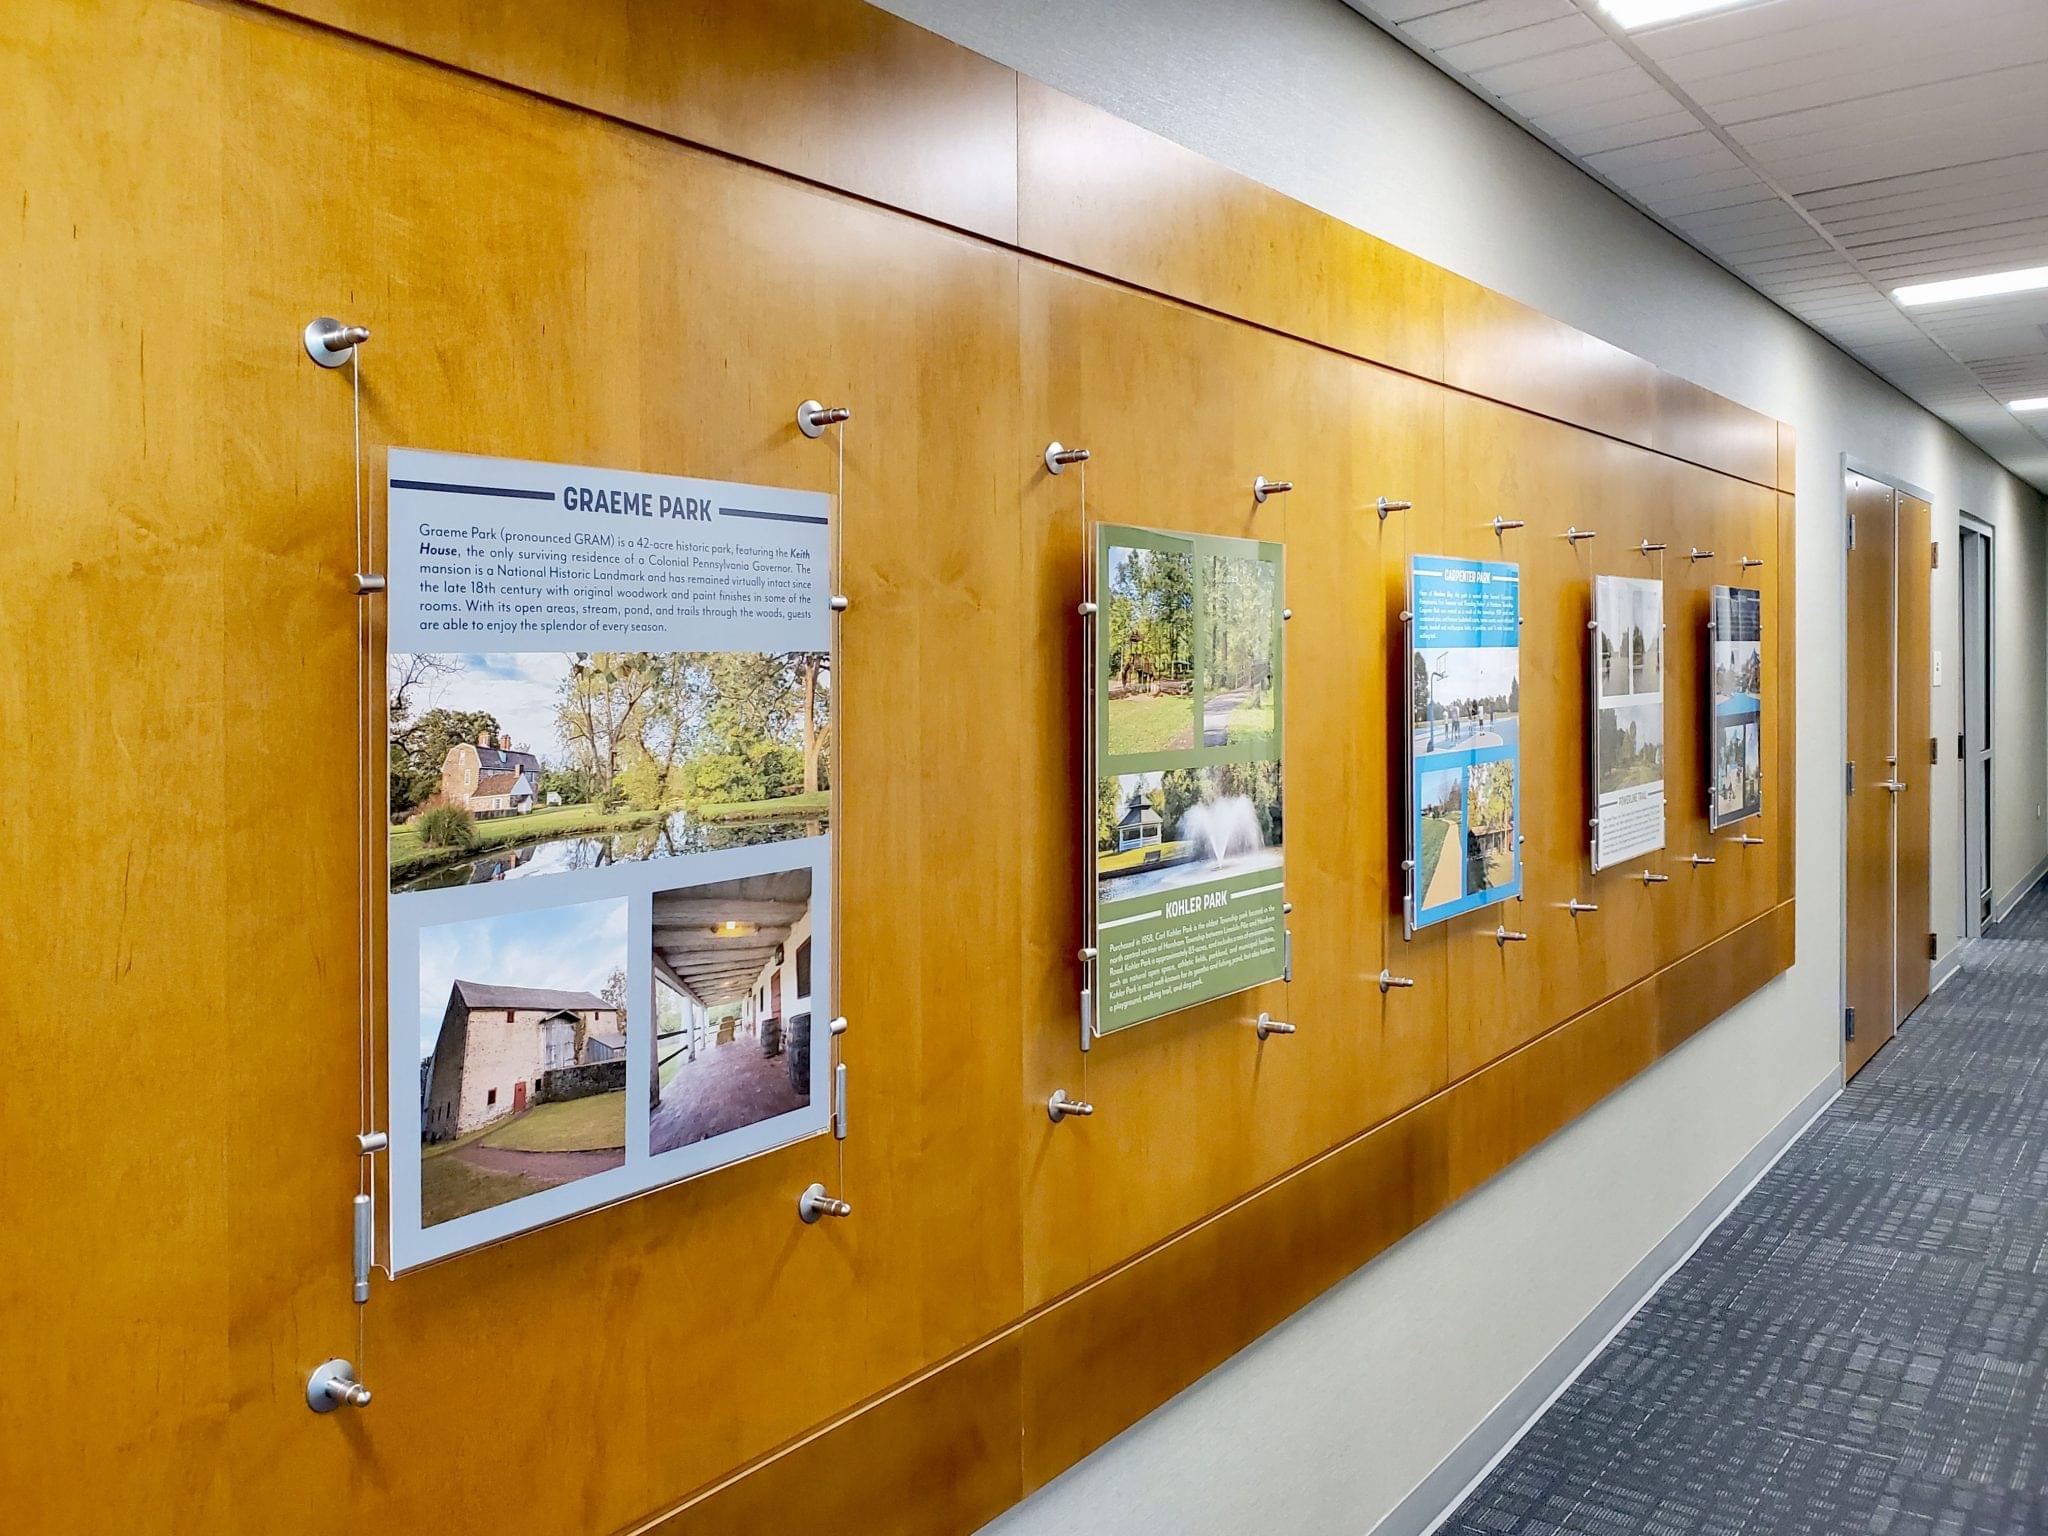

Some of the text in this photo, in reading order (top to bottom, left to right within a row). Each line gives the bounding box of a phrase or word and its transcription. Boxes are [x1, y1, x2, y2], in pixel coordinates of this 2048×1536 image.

[564, 486, 712, 522] GRAEME PARK
[420, 524, 468, 538] Graeme
[472, 527, 496, 539] Park
[500, 528, 571, 544] (pronounced
[574, 533, 615, 548] GRAM)
[618, 537, 625, 547] is
[637, 538, 673, 550] 42-acre
[676, 540, 709, 553] historic
[712, 544, 734, 555] park,
[736, 544, 773, 559] featuring
[776, 547, 788, 557] the
[790, 548, 810, 559] Keith
[420, 542, 460, 557] House,
[467, 545, 485, 557] the
[490, 548, 514, 561] only
[518, 550, 566, 564] surviving
[572, 551, 620, 564] residence
[624, 554, 634, 564] of
[649, 555, 689, 567] Colonial
[693, 557, 749, 571] Pennsylvania
[752, 561, 793, 573] Governor.
[796, 564, 811, 574] The
[420, 564, 811, 589] mansion is a National Historic Landmark and has remained virtually intact since
[1444, 569, 1491, 584] CARPENTER PARK
[420, 580, 439, 592] the
[444, 581, 466, 593] late
[471, 581, 496, 594] 18th
[500, 586, 542, 598] century
[546, 585, 569, 595] with
[574, 586, 612, 599] original
[617, 588, 667, 599] woodwork
[672, 590, 689, 599] and
[693, 591, 716, 602] paint
[720, 590, 751, 602] finishes
[754, 593, 761, 602] in
[789, 594, 796, 602] of
[800, 594, 811, 603] the
[420, 600, 811, 620] rooms. With its open areas, stream, pond, and trails through the woods, guests
[420, 618, 667, 633] are able to enjoy the splendor of every season.
[1166, 890, 1228, 919] KOHLER PARK
[1110, 939, 1135, 952] Purchased
[1167, 928, 1181, 937] Kohler
[1183, 925, 1192, 934] Park
[1110, 953, 1123, 964] north
[1124, 949, 1140, 960] central
[1125, 961, 1140, 971] Kohler
[1141, 958, 1151, 967] Park
[1129, 970, 1147, 982] natural
[1110, 988, 1125, 1000] Kohler
[1126, 984, 1137, 994] Park
